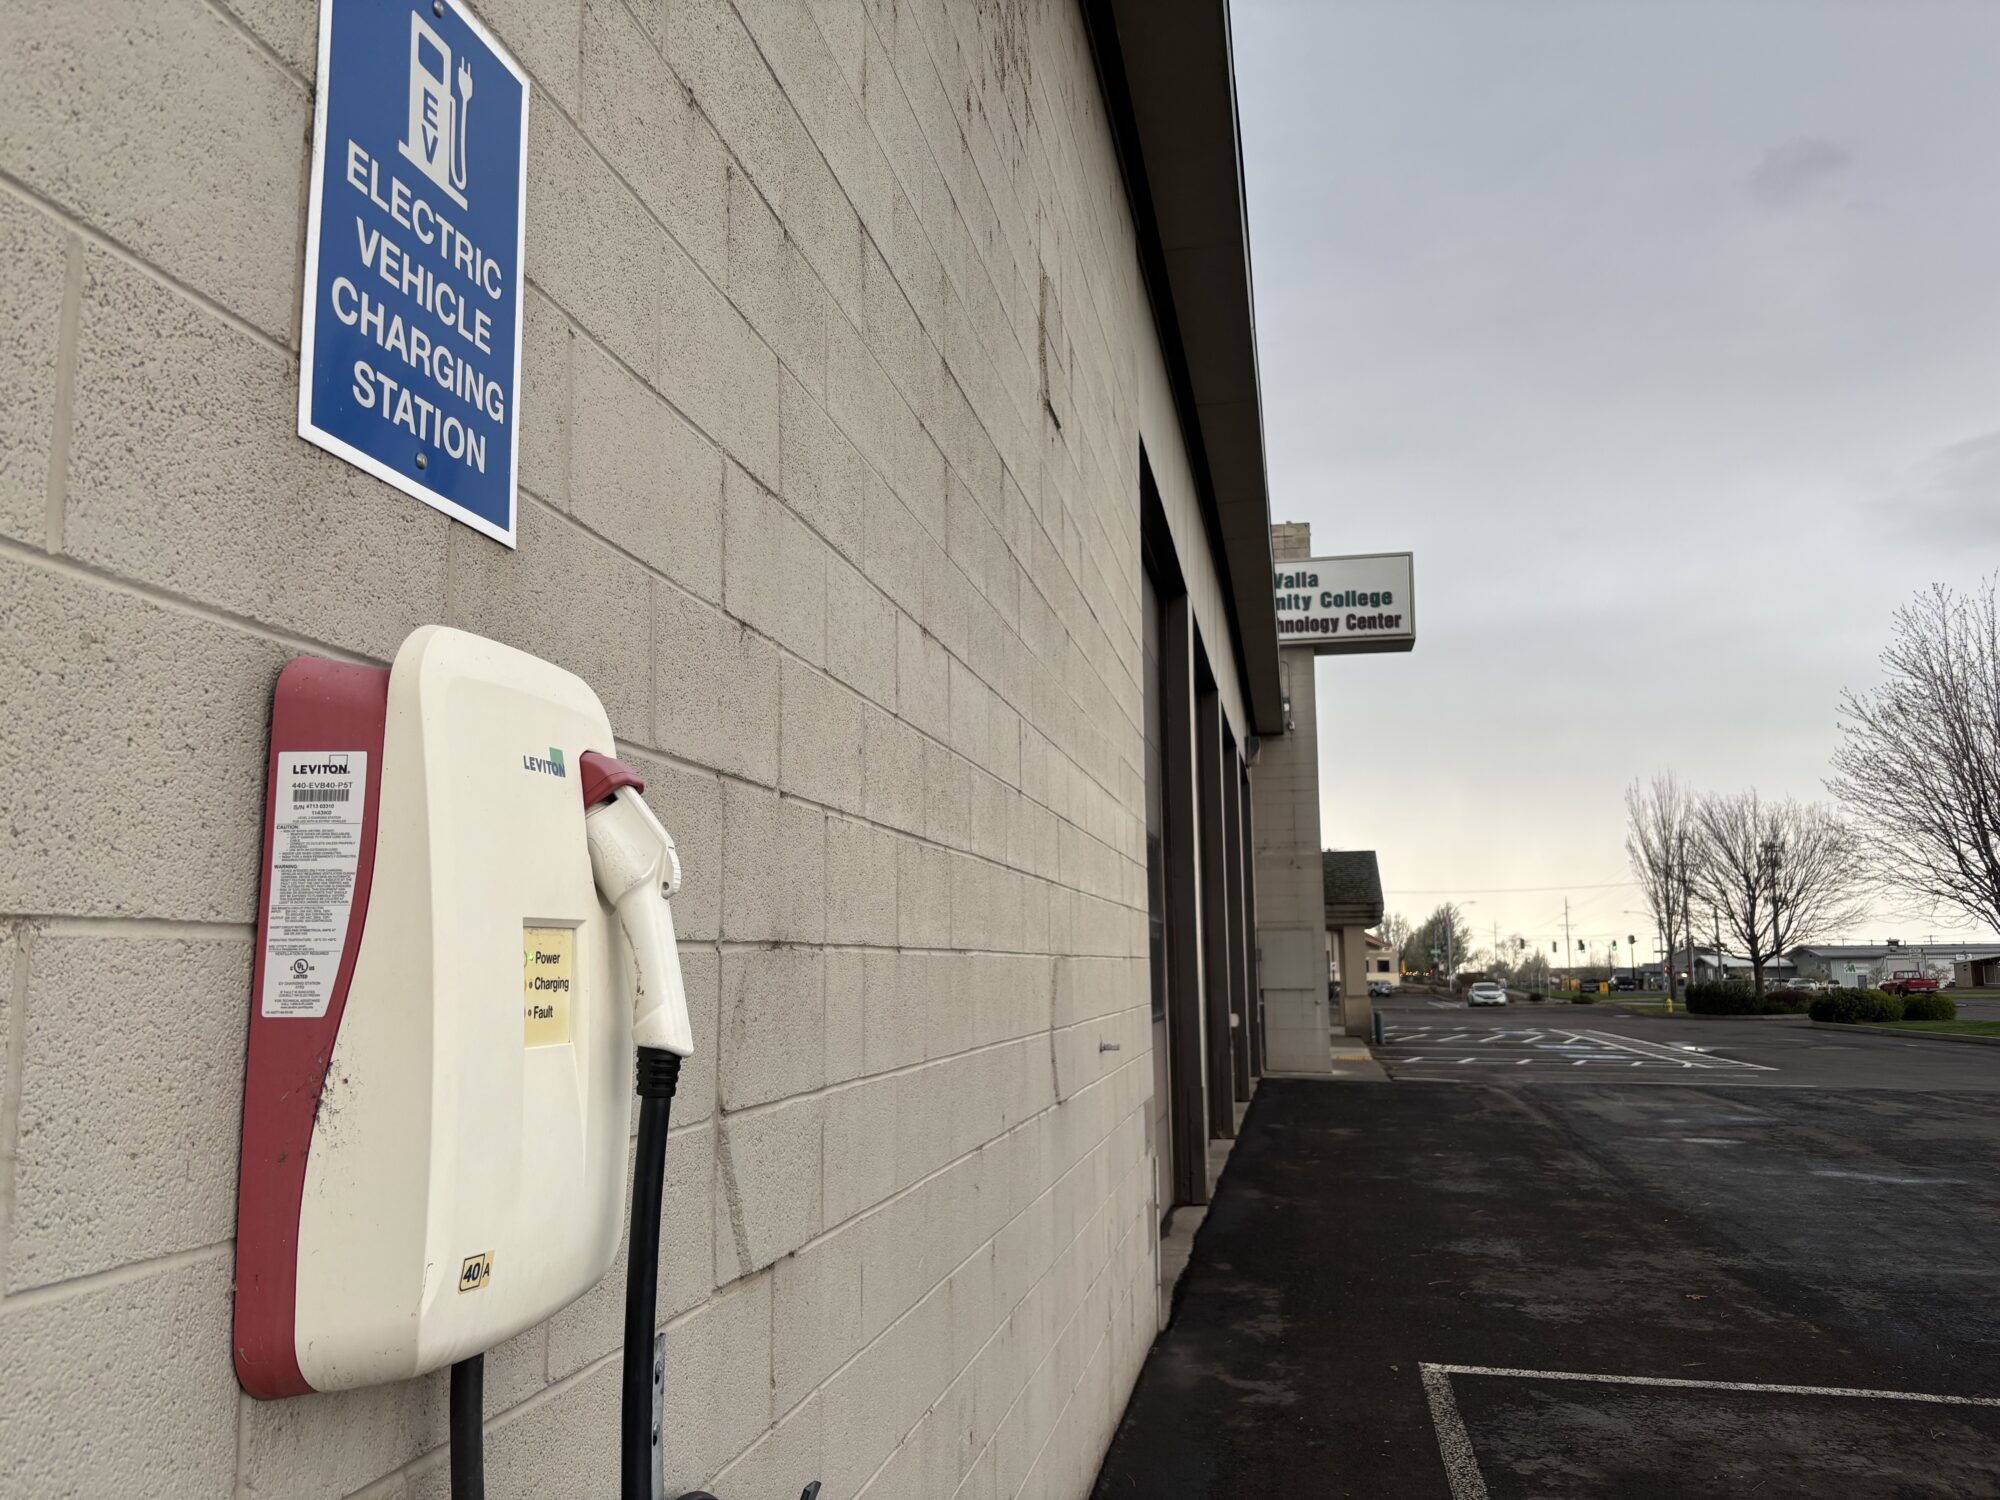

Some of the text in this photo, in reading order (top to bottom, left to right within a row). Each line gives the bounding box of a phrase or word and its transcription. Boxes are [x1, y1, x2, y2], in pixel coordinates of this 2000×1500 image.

[421, 87, 438, 165] EV
[347, 139, 502, 300] ELECTRIC
[356, 216, 491, 354] VEHICLE
[331, 276, 504, 424] CHARGING
[352, 361, 486, 474] STATION
[1320, 590, 1393, 608] College
[1346, 613, 1402, 631] Center
[292, 764, 348, 775] LEVITON
[523, 755, 566, 778] LEVITON
[535, 951, 560, 964] Power
[534, 976, 570, 993] Charging
[533, 1005, 553, 1019] Fault
[463, 1262, 490, 1283] 40 A
